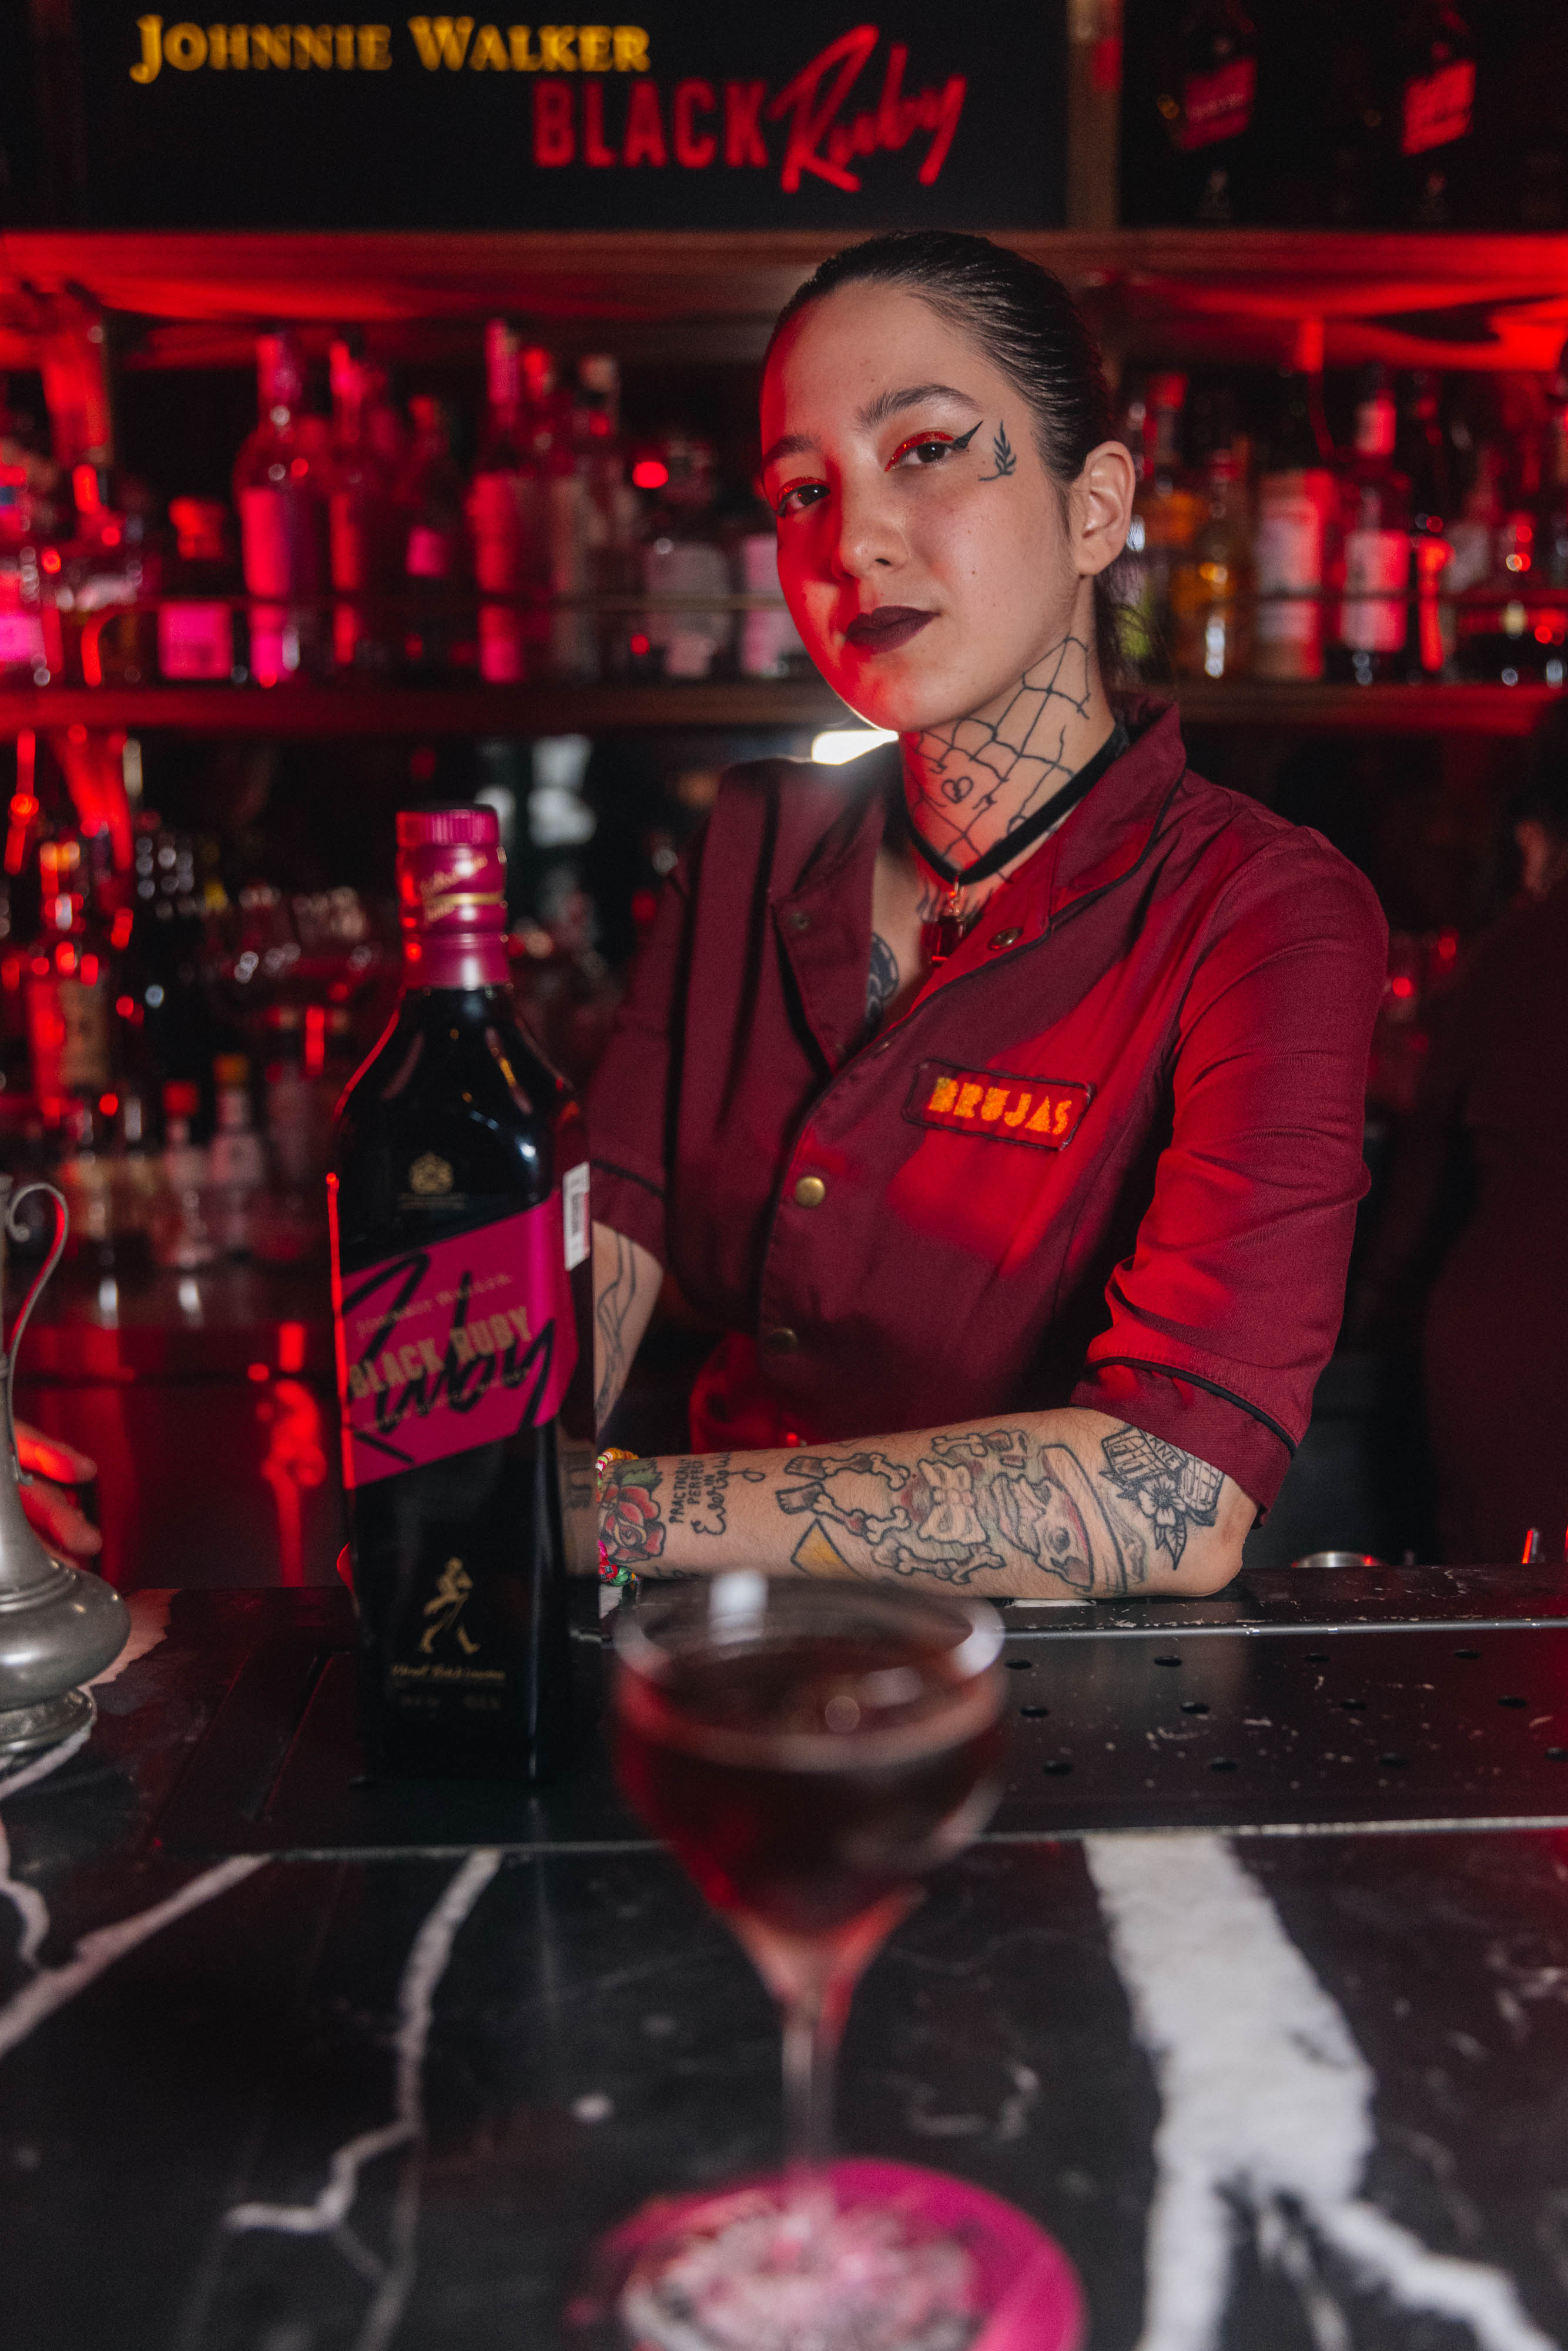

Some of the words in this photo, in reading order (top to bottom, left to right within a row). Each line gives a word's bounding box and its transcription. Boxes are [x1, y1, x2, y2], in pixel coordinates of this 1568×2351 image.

[130, 14, 392, 83] JOHNNIE
[408, 16, 651, 72] WALKER
[532, 79, 769, 168] BLACK
[768, 24, 967, 193] Ruby
[929, 1077, 1071, 1135] BRUJAS
[349, 1338, 445, 1398] BLACK
[449, 1305, 532, 1362] RUBY
[668, 1459, 691, 1523] PRACTICALLY
[686, 1460, 704, 1505] PERFECT
[704, 1474, 715, 1486] IN
